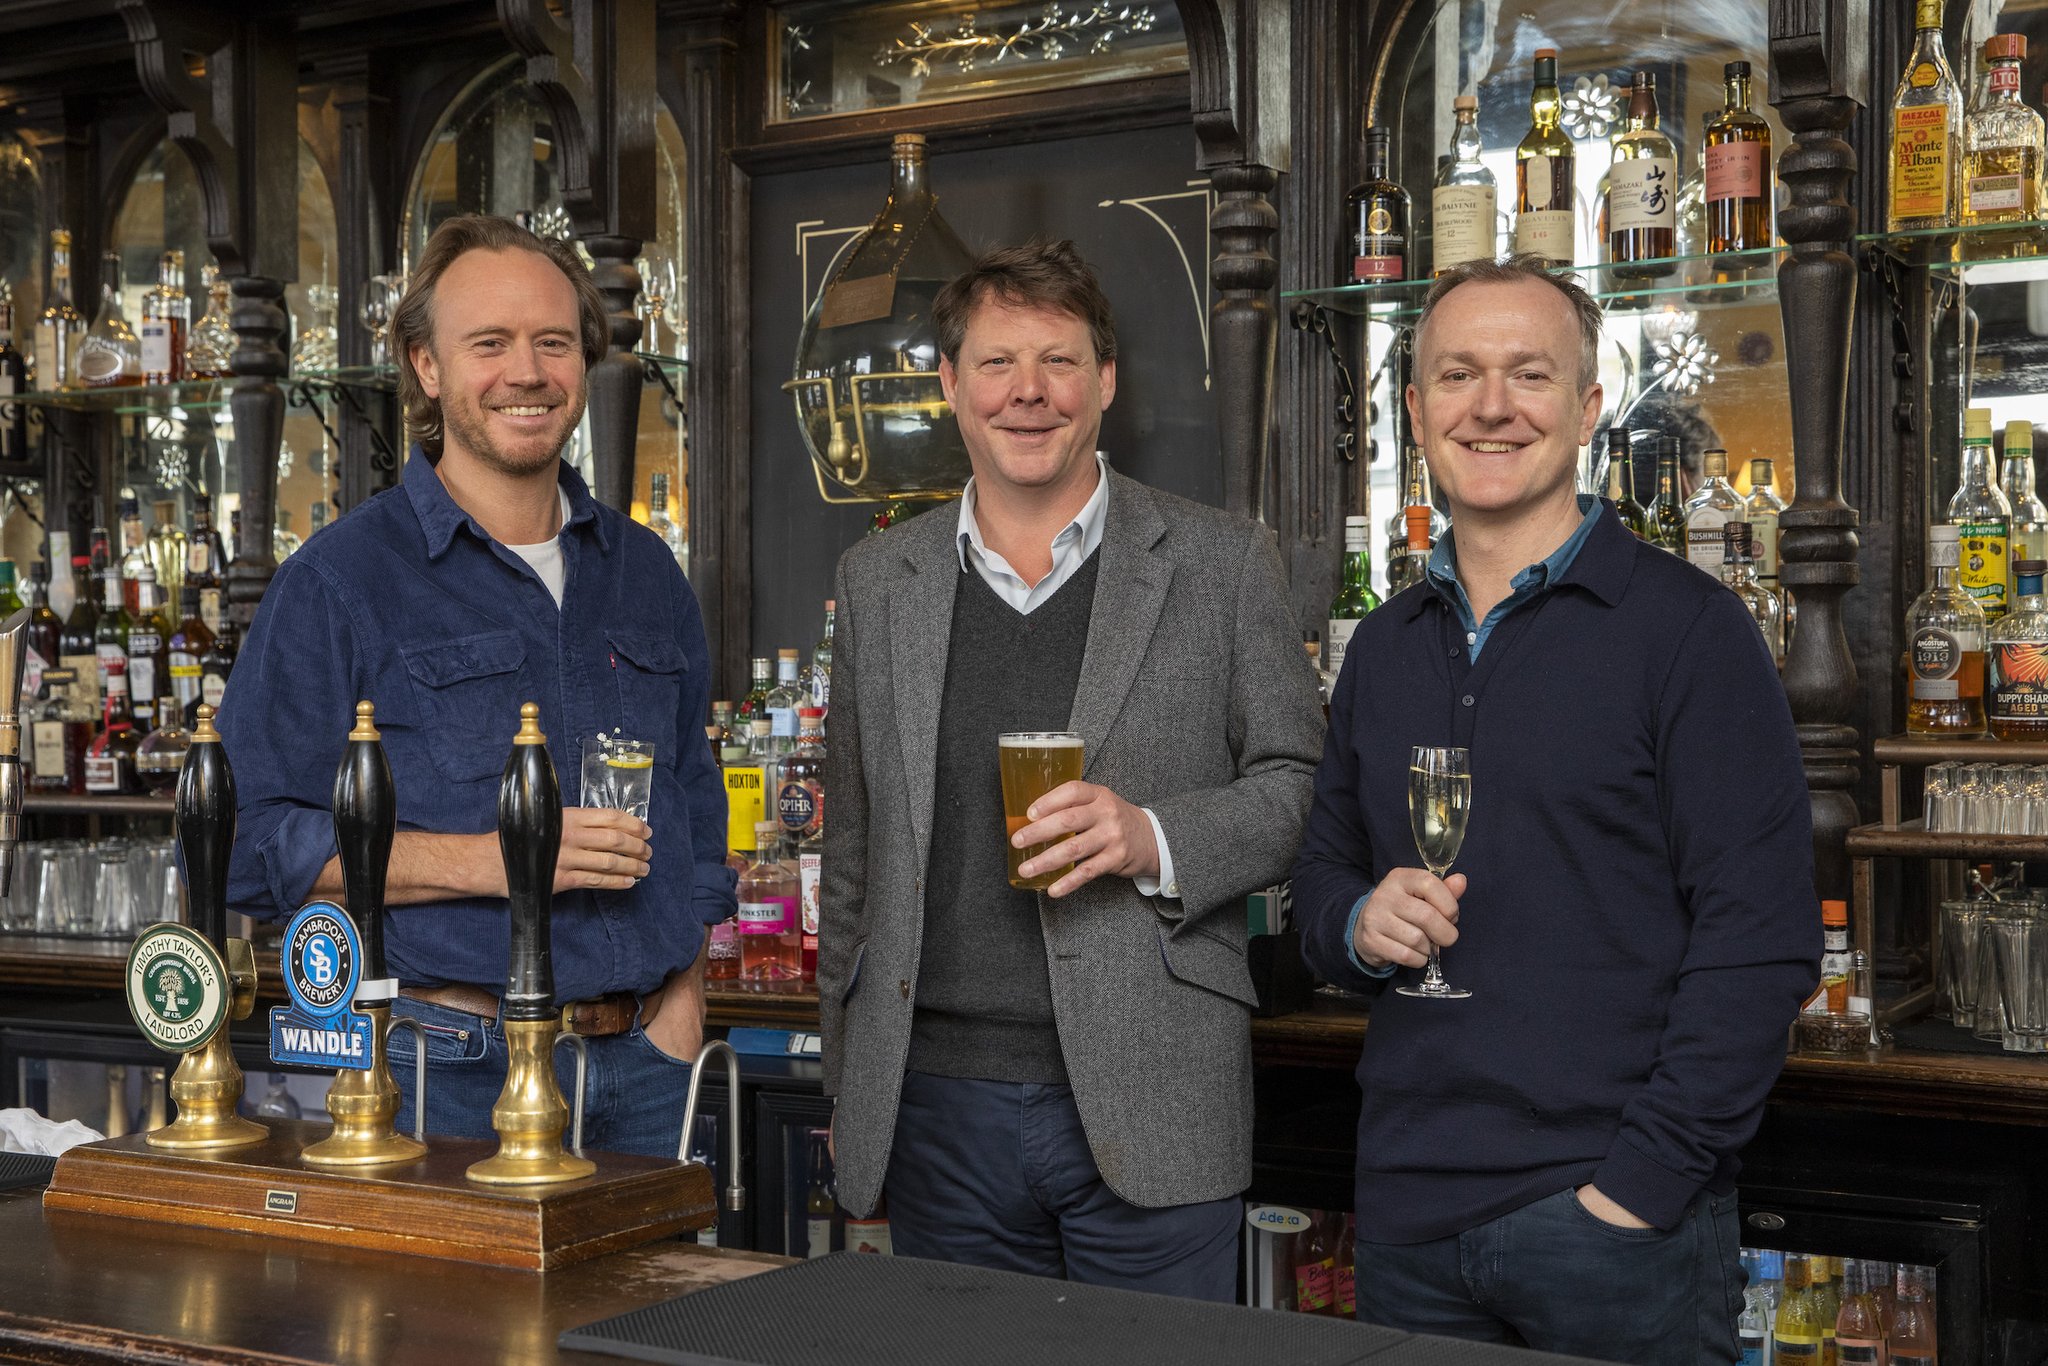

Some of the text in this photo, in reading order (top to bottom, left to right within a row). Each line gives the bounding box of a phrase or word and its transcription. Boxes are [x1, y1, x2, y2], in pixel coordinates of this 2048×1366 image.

[1902, 110, 1941, 120] MEZCAL
[1899, 140, 1943, 154] Monte
[1899, 153, 1942, 167] Alban
[1374, 261, 1385, 271] 12
[1975, 526, 2003, 534] NEPHEW
[1967, 574, 1989, 584] White
[1917, 640, 1949, 648] ANGOSTURA
[1917, 652, 1949, 662] 1919
[1997, 693, 2048, 704] DUPPY SHAR
[2010, 703, 2038, 712] AGED
[728, 774, 760, 789] HOXTON
[780, 799, 812, 812] OPIHR
[740, 909, 777, 917] PINKSTER
[294, 919, 348, 954] SAMBROOK'S
[134, 938, 215, 987] TIMOTHY TAYLOR'S
[148, 959, 184, 978] CHAMPIONSHIP
[298, 978, 343, 1002] BREWERY
[144, 1012, 204, 1040] LANDLORD
[280, 1027, 363, 1057] WANDLE
[1258, 1210, 1300, 1226] Adexa
